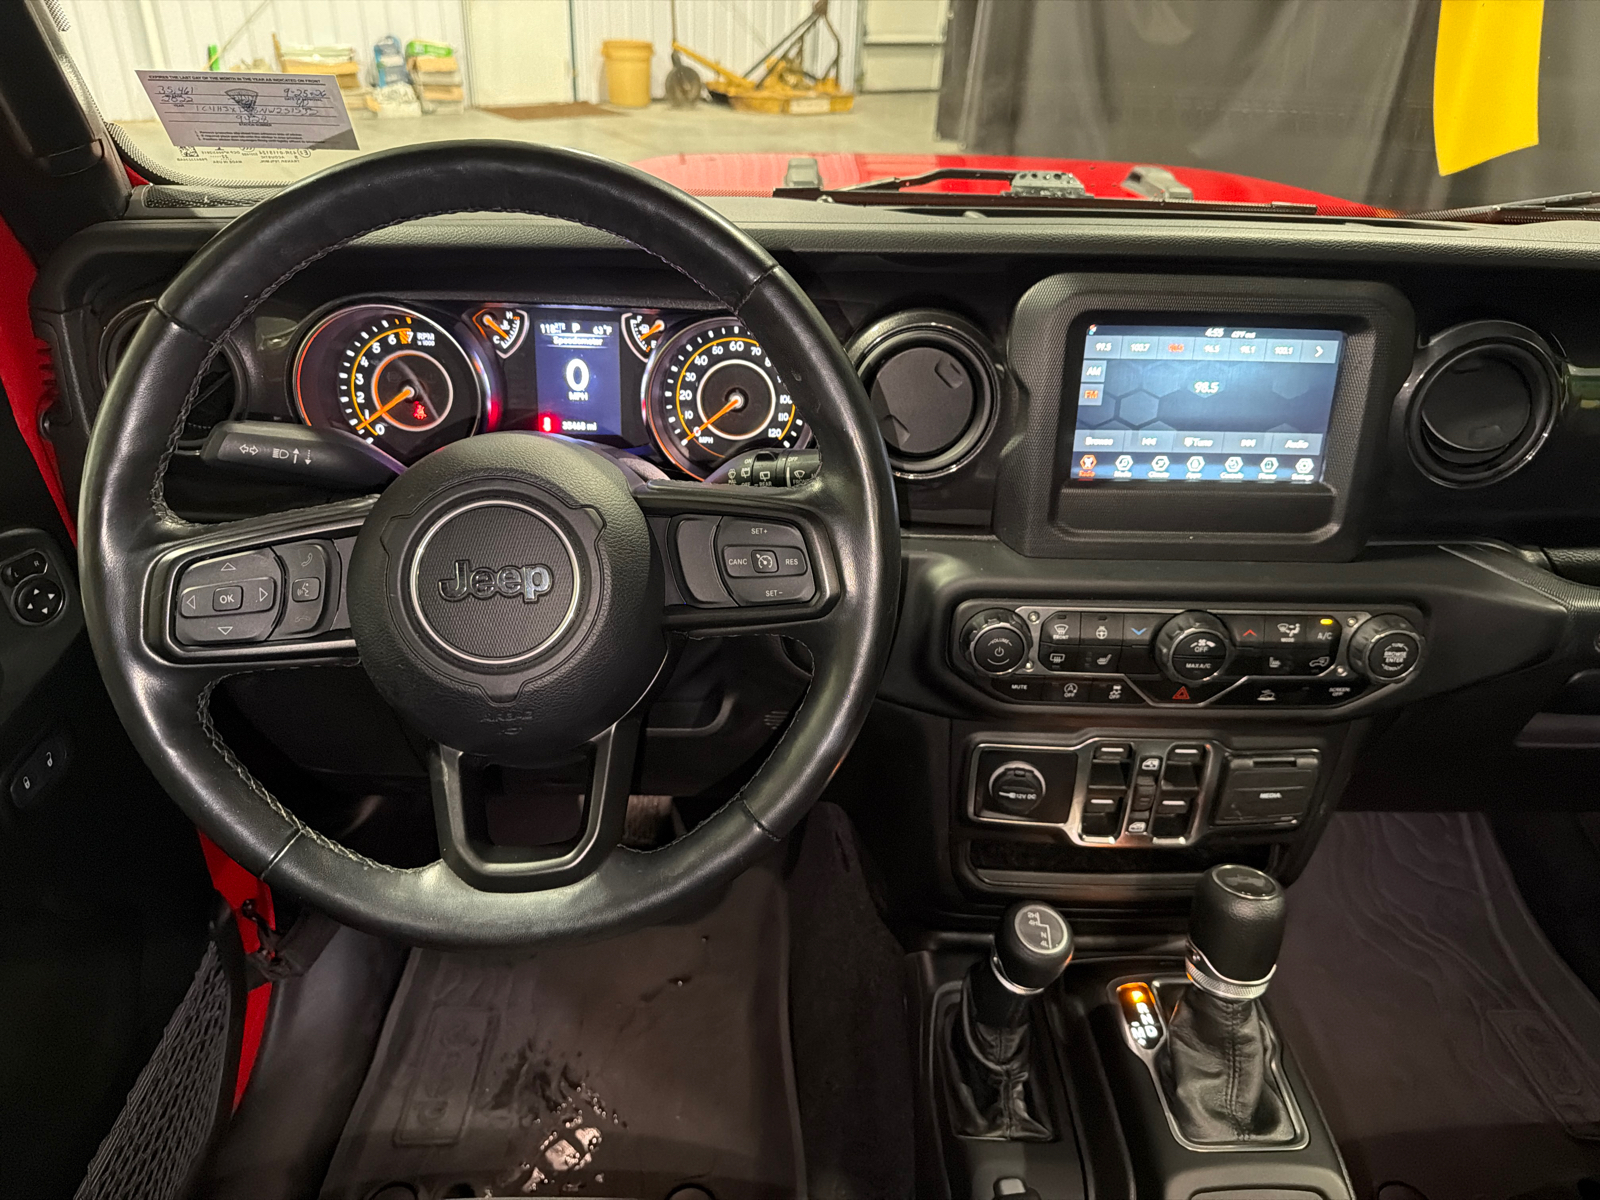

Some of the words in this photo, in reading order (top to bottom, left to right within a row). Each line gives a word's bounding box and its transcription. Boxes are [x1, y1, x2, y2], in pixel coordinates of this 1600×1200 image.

[505, 311, 514, 319] H
[636, 315, 643, 323] F
[571, 322, 581, 333] P
[387, 334, 397, 345] 6
[406, 331, 414, 343] 7
[416, 332, 435, 340] RPM
[492, 336, 501, 344] C
[372, 342, 381, 353] 5
[650, 340, 657, 348] E
[712, 343, 724, 355] 50
[729, 341, 744, 351] 60
[750, 347, 762, 356] 70
[360, 357, 369, 367] 4
[694, 355, 708, 366] 40
[565, 358, 590, 392] 0
[1086, 366, 1102, 376] AM
[355, 373, 364, 385] 3
[685, 372, 697, 382] 30
[1194, 381, 1220, 394] 98.5
[356, 391, 365, 403] 2
[679, 391, 693, 400] 20
[1084, 390, 1099, 399] FM
[685, 411, 694, 419] 10
[778, 412, 789, 422] 110
[375, 424, 385, 435] 0
[768, 428, 782, 438] 120
[1284, 439, 1309, 449] Audio
[728, 558, 748, 566] CANC
[785, 558, 798, 566] RES
[438, 558, 553, 604] Jeep
[219, 594, 234, 604] OK
[1317, 632, 1333, 640] A/C
[1136, 1002, 1149, 1014] R
[1140, 1013, 1154, 1025] N
[1131, 1026, 1147, 1039] M
[1144, 1025, 1158, 1038] D
